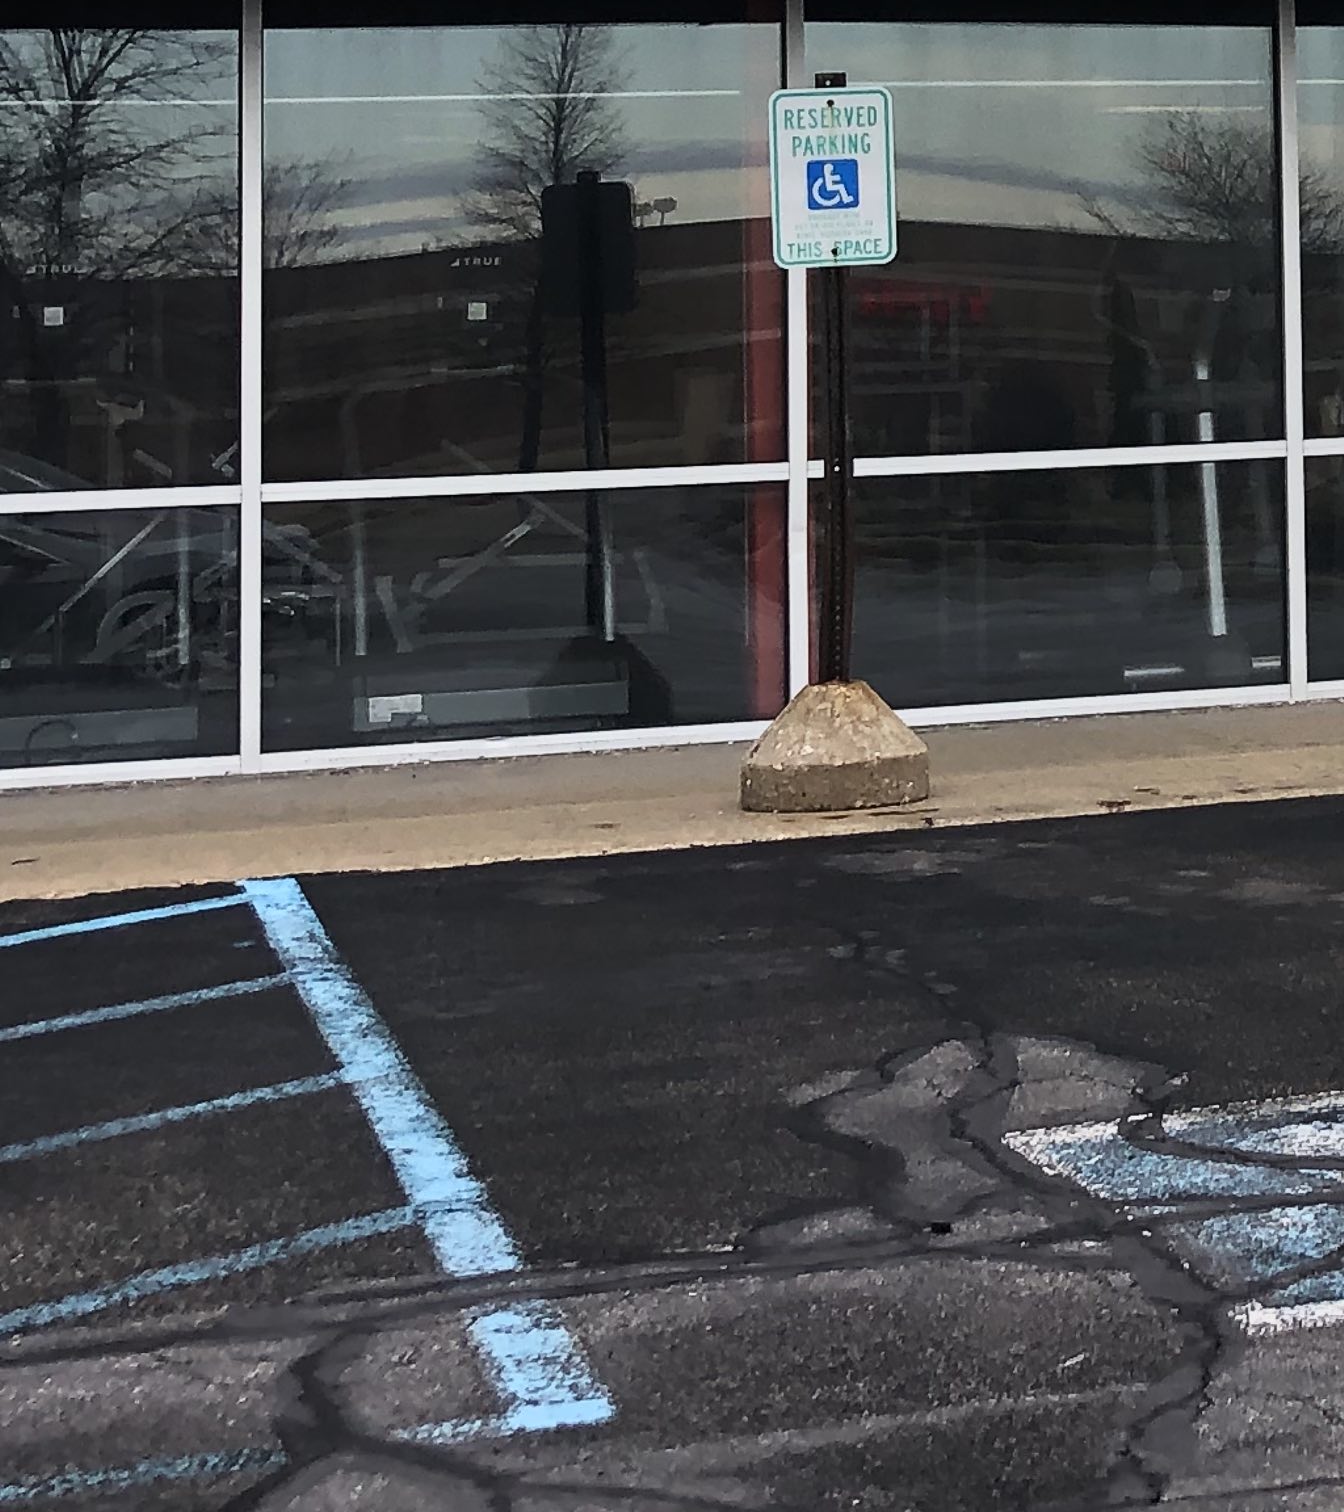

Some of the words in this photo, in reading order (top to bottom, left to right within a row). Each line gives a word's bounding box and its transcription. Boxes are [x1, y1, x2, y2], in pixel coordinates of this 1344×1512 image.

[784, 106, 877, 130] RESERVED
[792, 133, 871, 157] PARKING
[787, 241, 822, 259] THIS
[833, 239, 882, 256] SPACE
